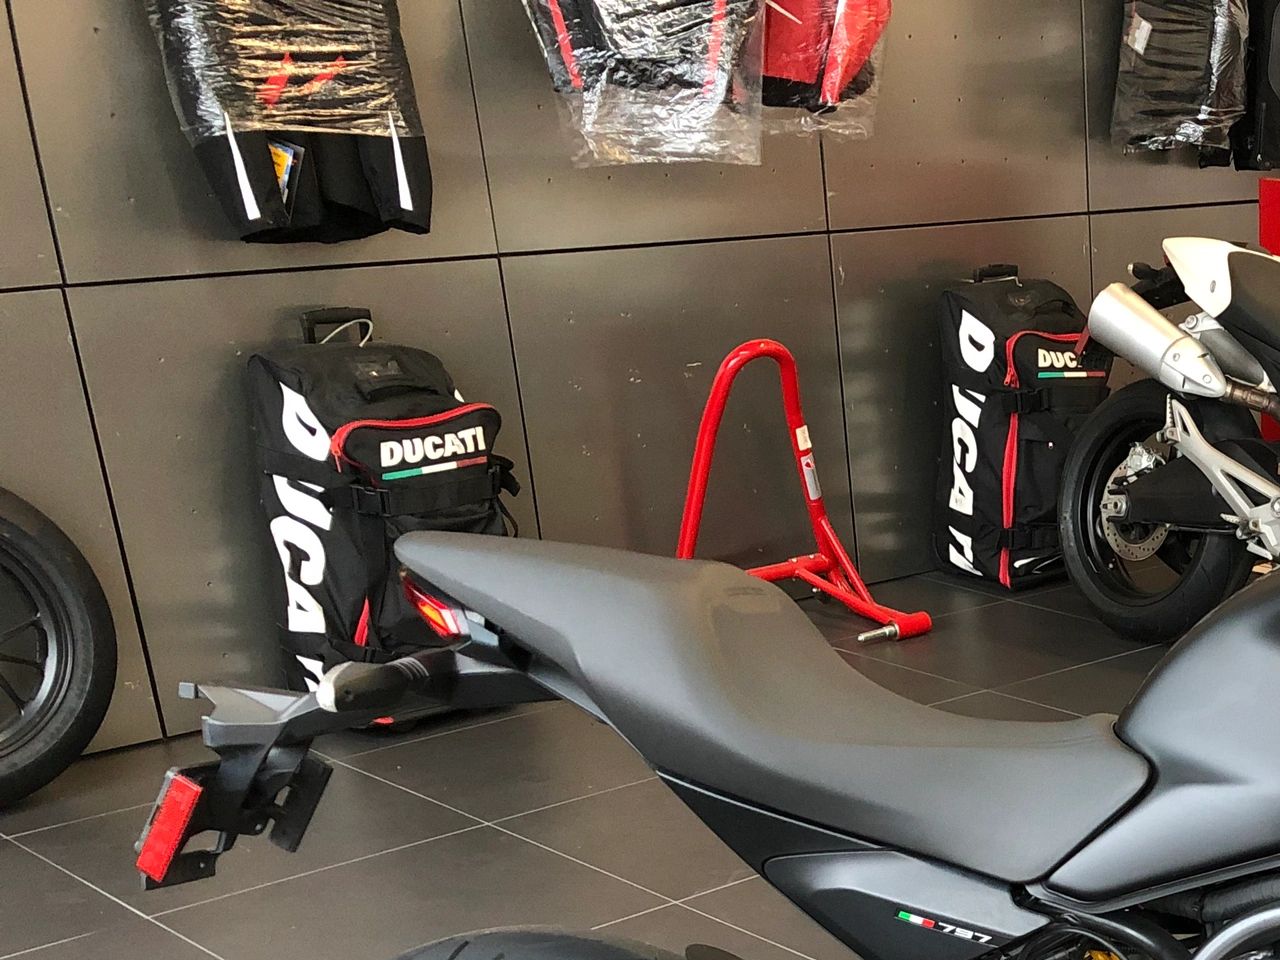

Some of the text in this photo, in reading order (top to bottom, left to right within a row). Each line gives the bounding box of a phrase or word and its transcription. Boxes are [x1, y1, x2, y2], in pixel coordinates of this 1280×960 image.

[1037, 348, 1086, 369] DUC
[380, 426, 486, 467] DUCATI
[938, 922, 993, 943] 797
